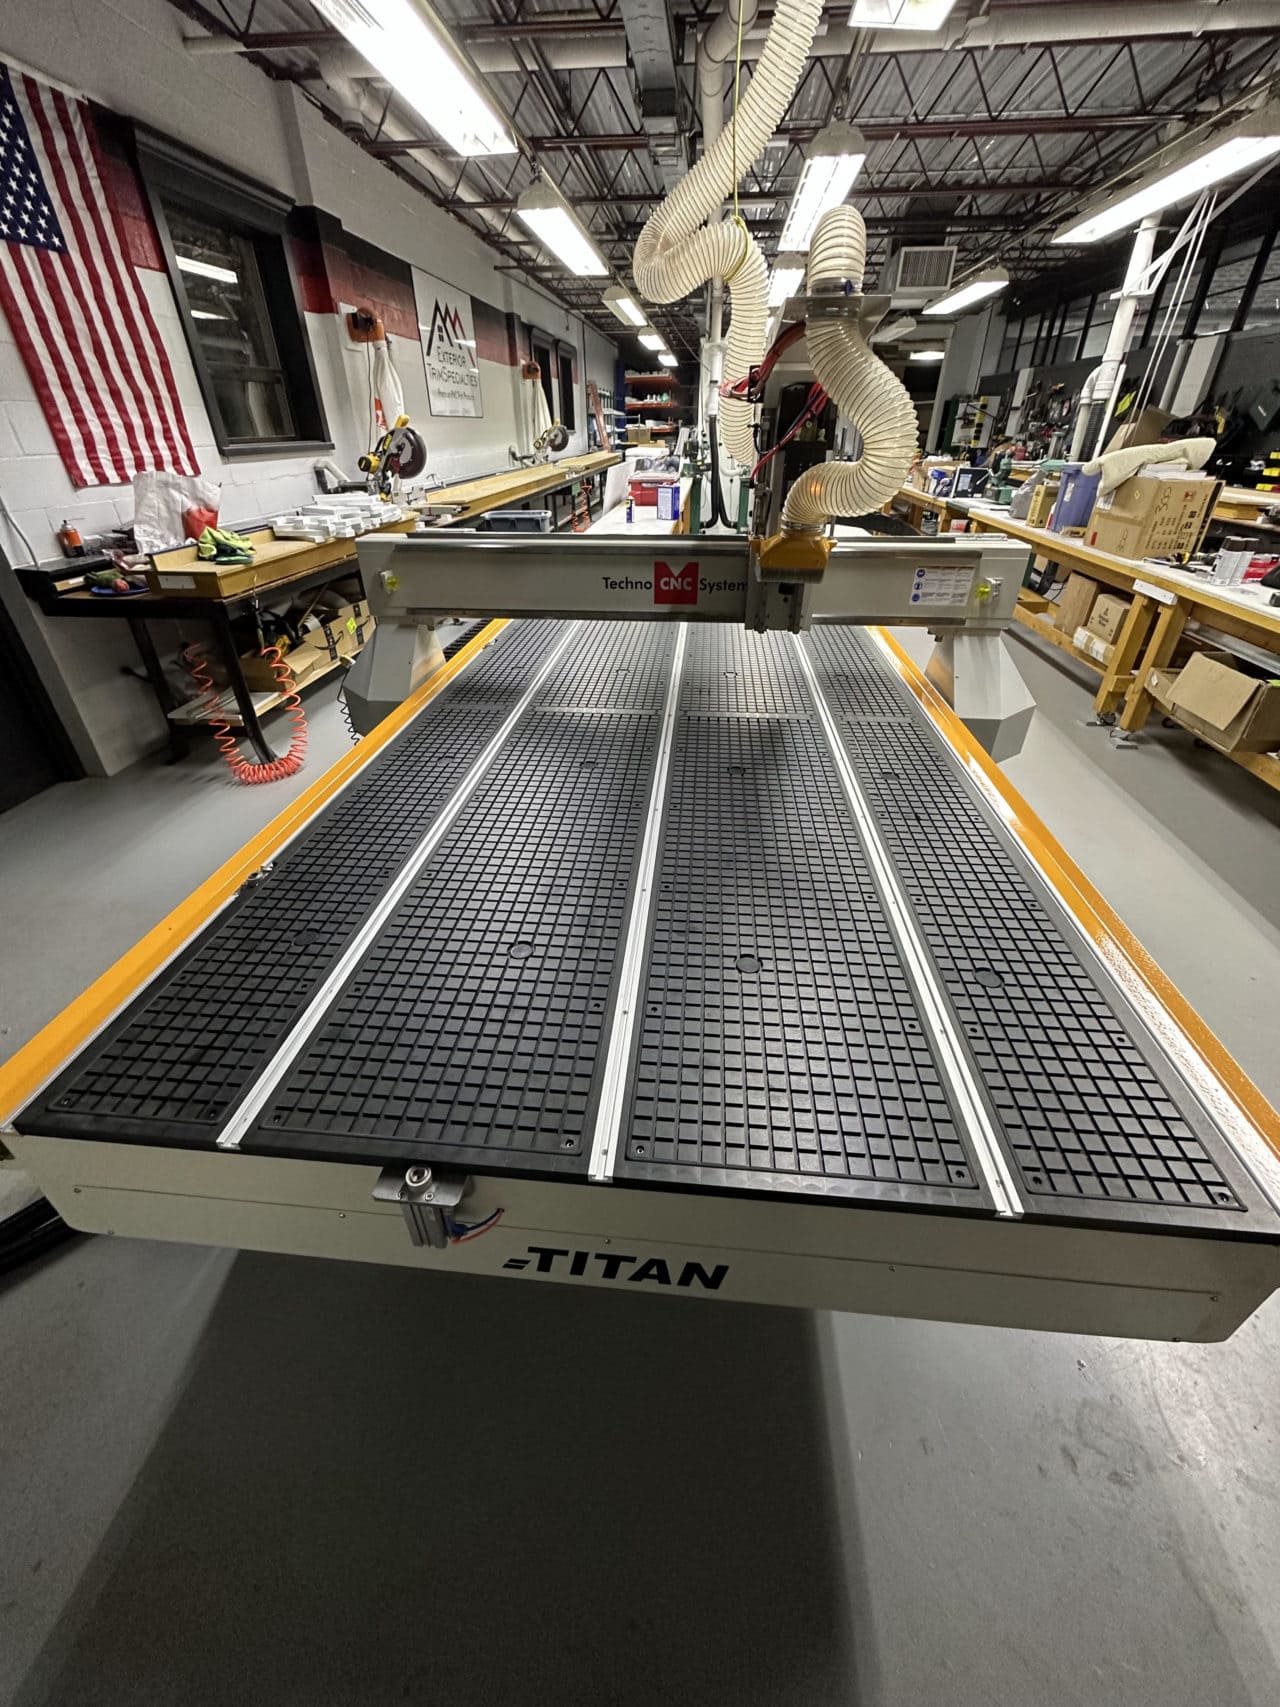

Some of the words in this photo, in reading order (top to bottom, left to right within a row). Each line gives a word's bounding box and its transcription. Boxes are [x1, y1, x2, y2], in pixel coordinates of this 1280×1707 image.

[602, 577, 652, 591] Techno
[659, 577, 693, 591] CNC
[527, 1246, 730, 1290] TITAN
